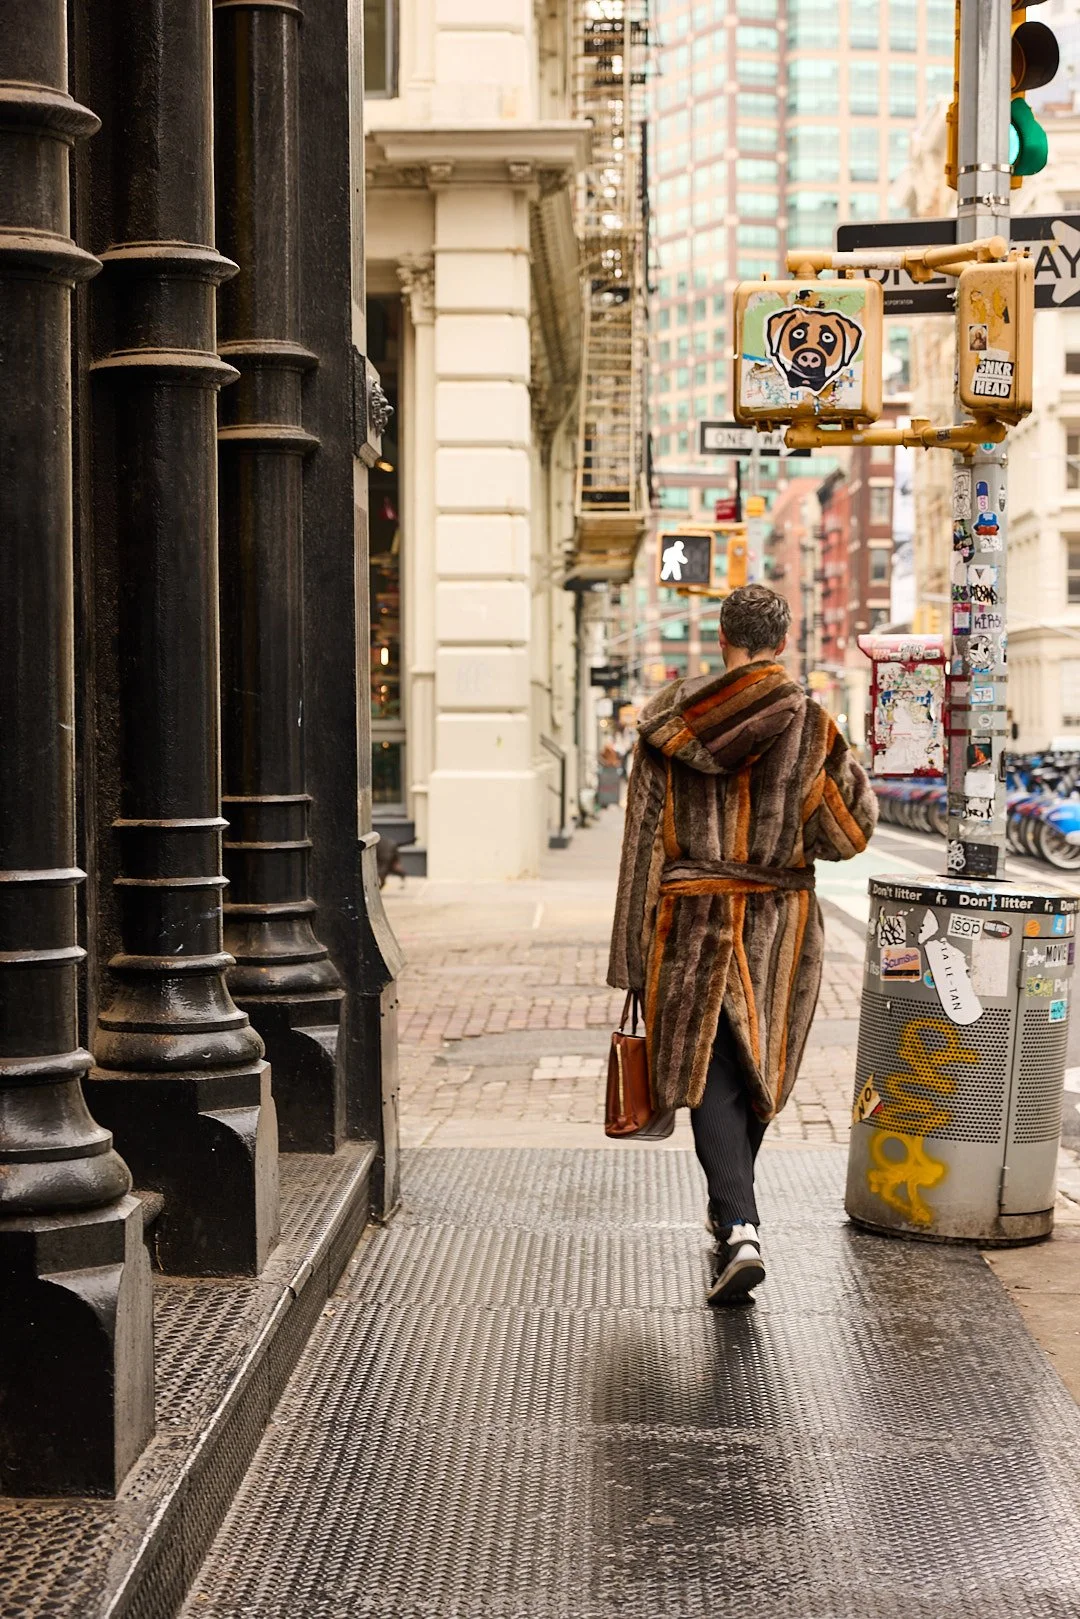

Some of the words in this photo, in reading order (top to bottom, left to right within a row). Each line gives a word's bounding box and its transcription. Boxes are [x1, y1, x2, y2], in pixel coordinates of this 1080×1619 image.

[1010, 245, 1080, 280] AY
[977, 360, 1013, 376] SNKR
[975, 380, 1010, 397] HEAD
[715, 432, 746, 445] ONE
[763, 433, 785, 445] WA
[872, 884, 893, 898] Don't
[894, 887, 923, 901] litter
[1001, 897, 1034, 909] litter
